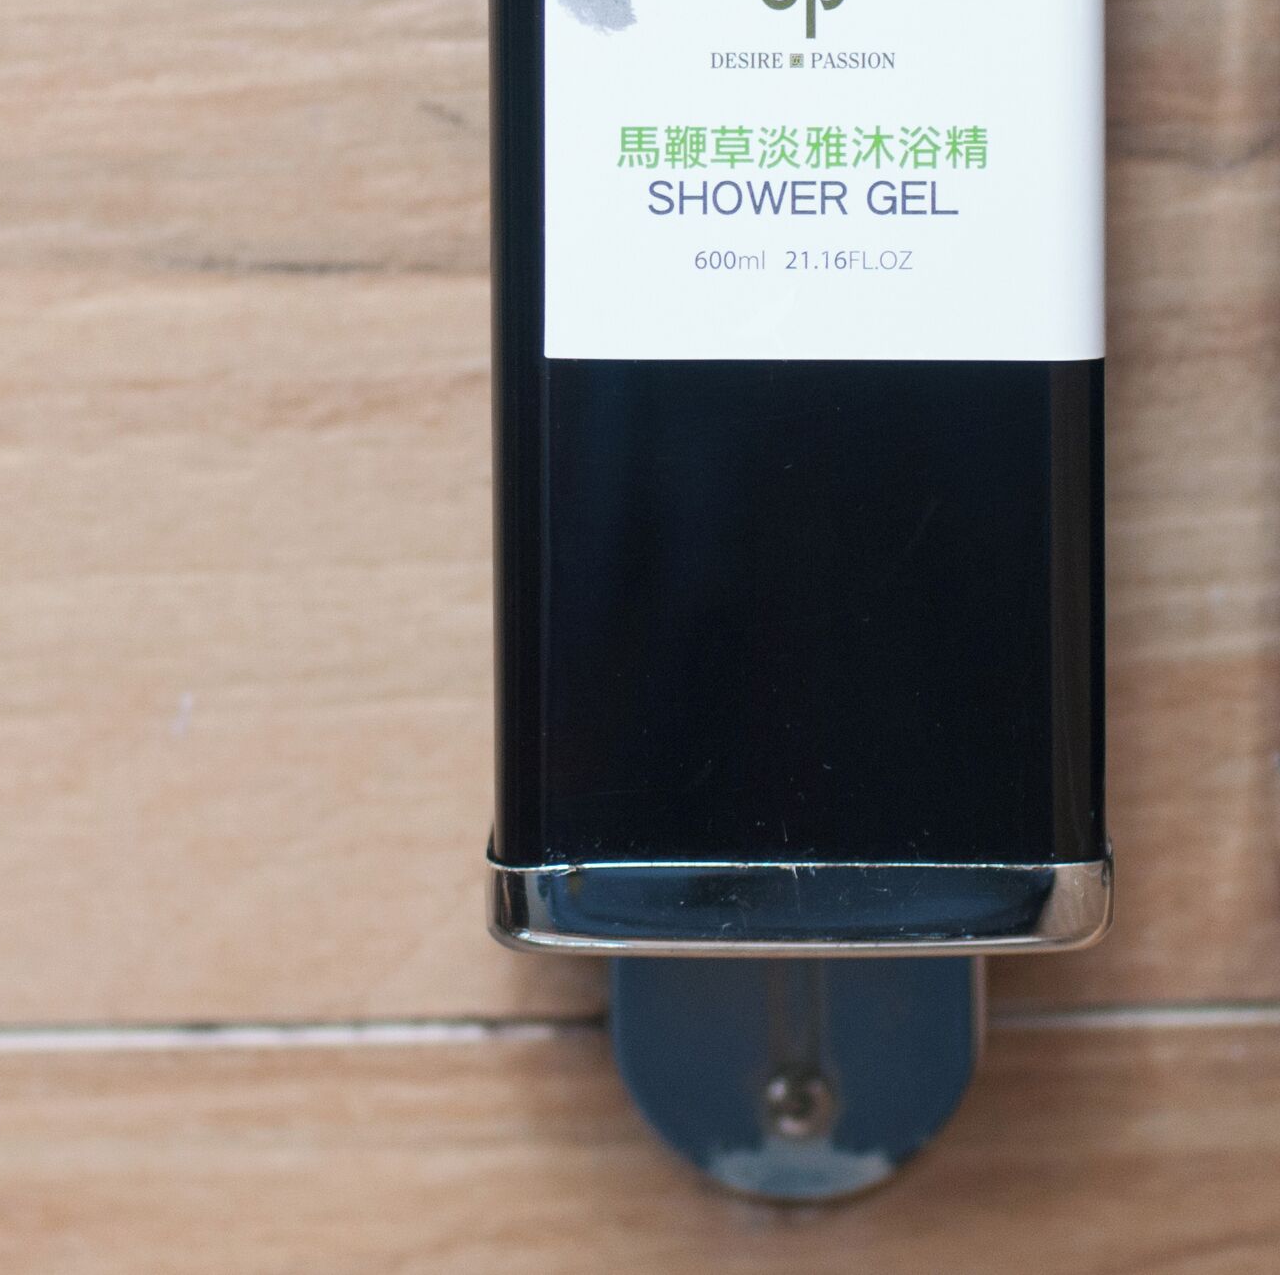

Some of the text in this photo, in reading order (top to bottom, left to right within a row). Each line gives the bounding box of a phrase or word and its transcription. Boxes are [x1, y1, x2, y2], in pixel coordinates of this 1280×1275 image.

[710, 53, 783, 69] DESIRE
[811, 53, 895, 69] PASSION
[617, 125, 989, 169] 馬鞭草淡雅沐浴精
[648, 181, 959, 215] SHOWER GEL
[694, 250, 913, 270] 600ml 21.16FL.OZ
